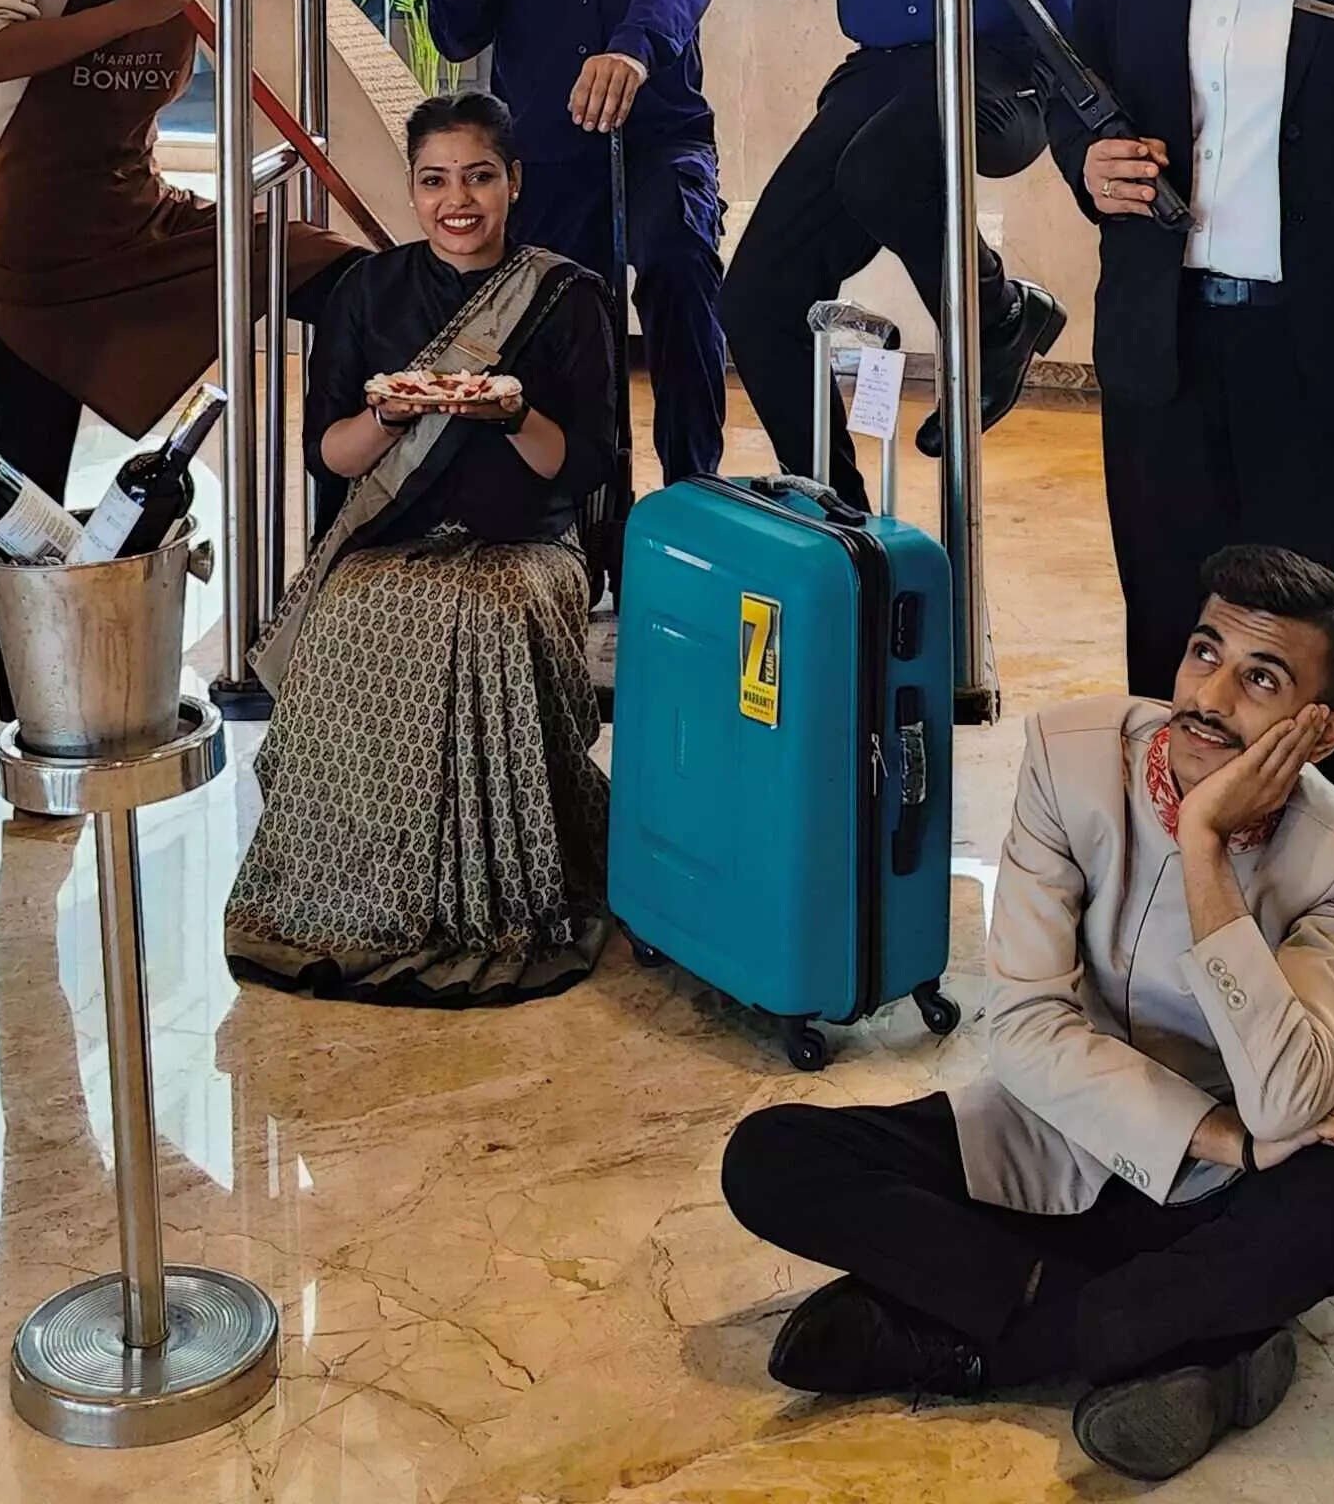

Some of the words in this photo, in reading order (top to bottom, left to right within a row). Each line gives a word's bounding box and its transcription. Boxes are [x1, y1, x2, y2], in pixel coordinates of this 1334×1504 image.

[92, 52, 163, 65] MARRIOTT
[72, 66, 175, 90] BONVOY
[742, 598, 772, 683] 7
[765, 648, 775, 683] YEARS
[743, 689, 774, 711] WARRANTY
